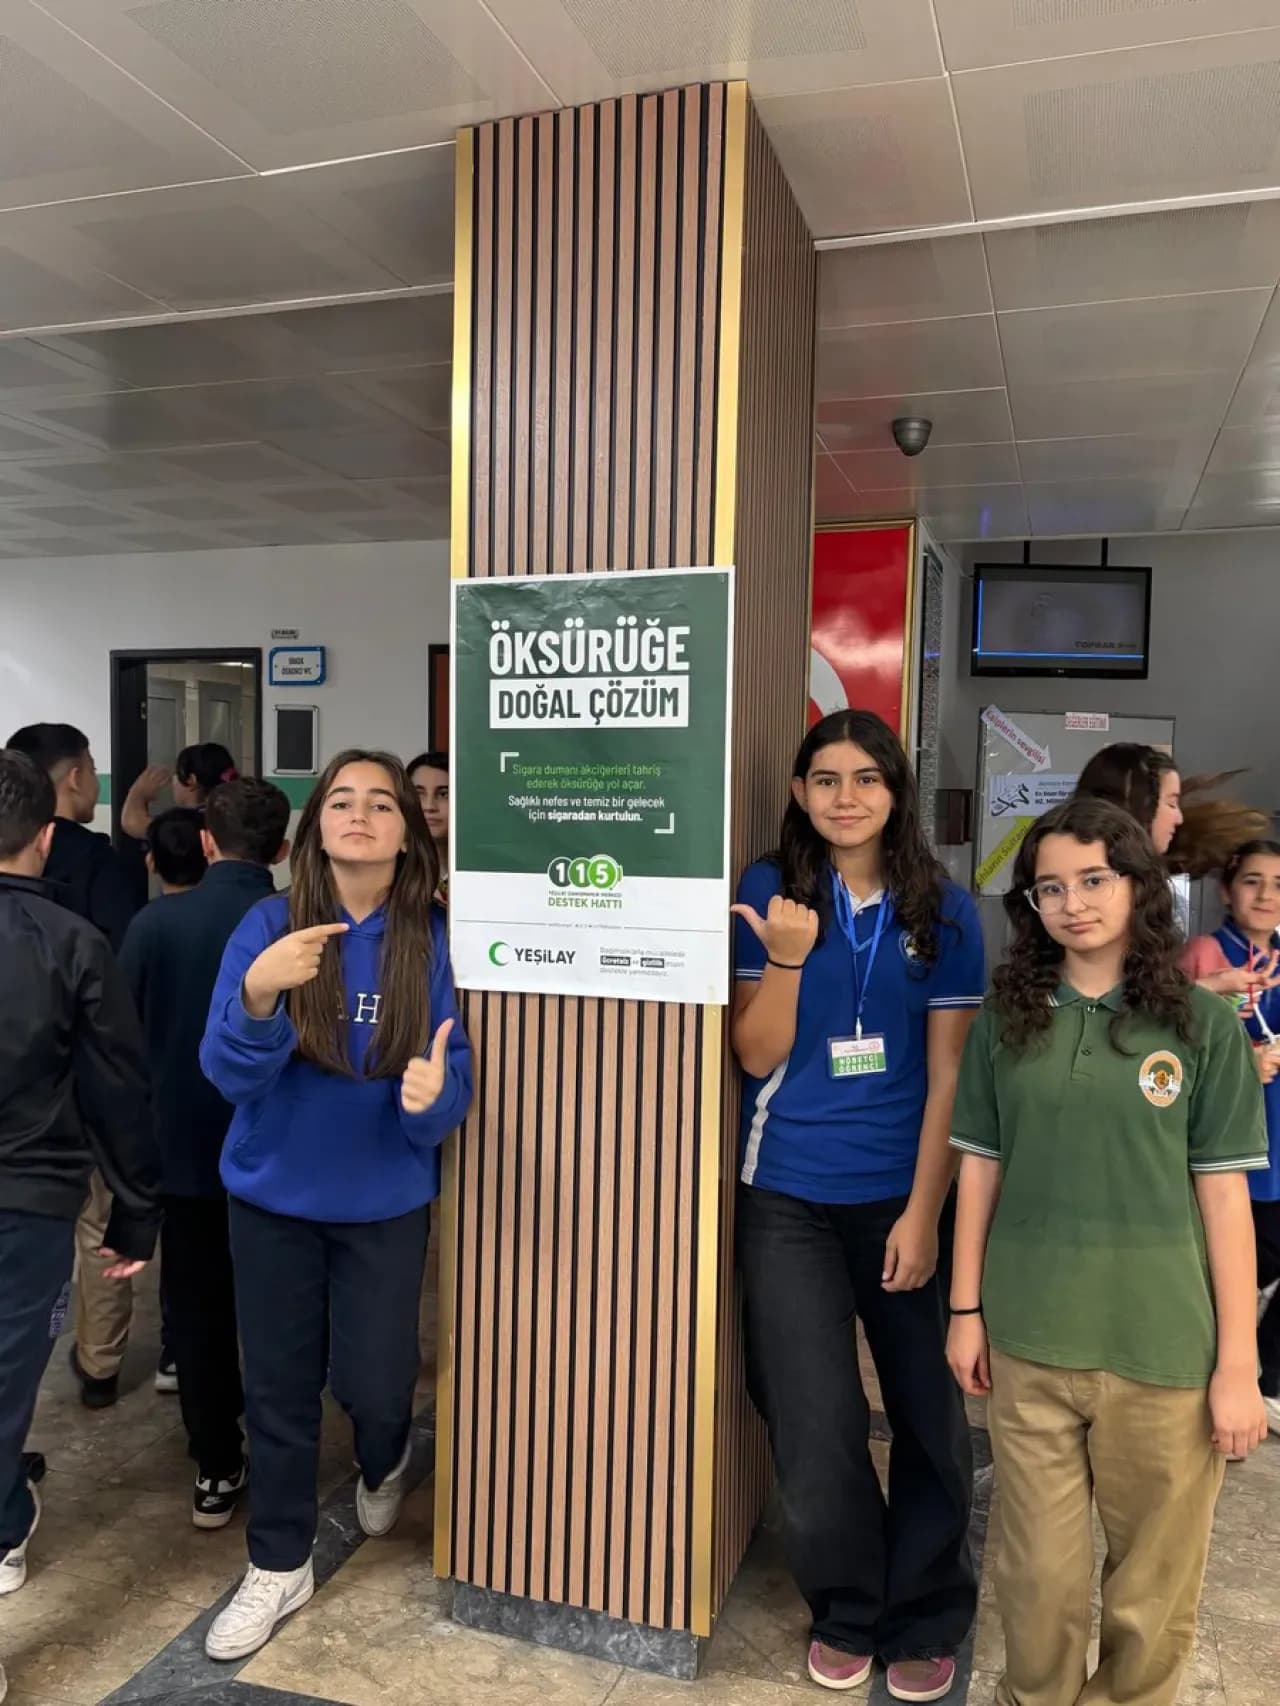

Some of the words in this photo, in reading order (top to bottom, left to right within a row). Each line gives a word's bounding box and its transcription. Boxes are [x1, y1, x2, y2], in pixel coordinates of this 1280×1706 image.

[489, 616, 690, 676] ÖKSÜRÜĞE
[499, 683, 581, 719] DOĞAL
[589, 679, 679, 725] ÇÖZÜM
[513, 764, 541, 776] Sigara
[544, 765, 578, 775] dumanı
[580, 764, 630, 776] akciğerleri
[632, 764, 661, 776] tahriş
[527, 778, 558, 789] ederek
[561, 778, 604, 791] öksürüğe
[606, 779, 620, 792] yol
[622, 780, 646, 792] açar.
[508, 795, 540, 808] Sağlıklı
[543, 795, 568, 807] nefes
[570, 798, 581, 807] ve
[583, 796, 610, 807] temiz
[612, 796, 625, 807] bir
[627, 796, 665, 810] gelecek
[528, 808, 546, 822] için
[547, 809, 596, 822] sigaradan
[598, 809, 644, 821] kurtulun.
[548, 897, 588, 908] DESTEK
[591, 899, 622, 909] HATTI
[514, 948, 576, 966] YEŞİLAY
